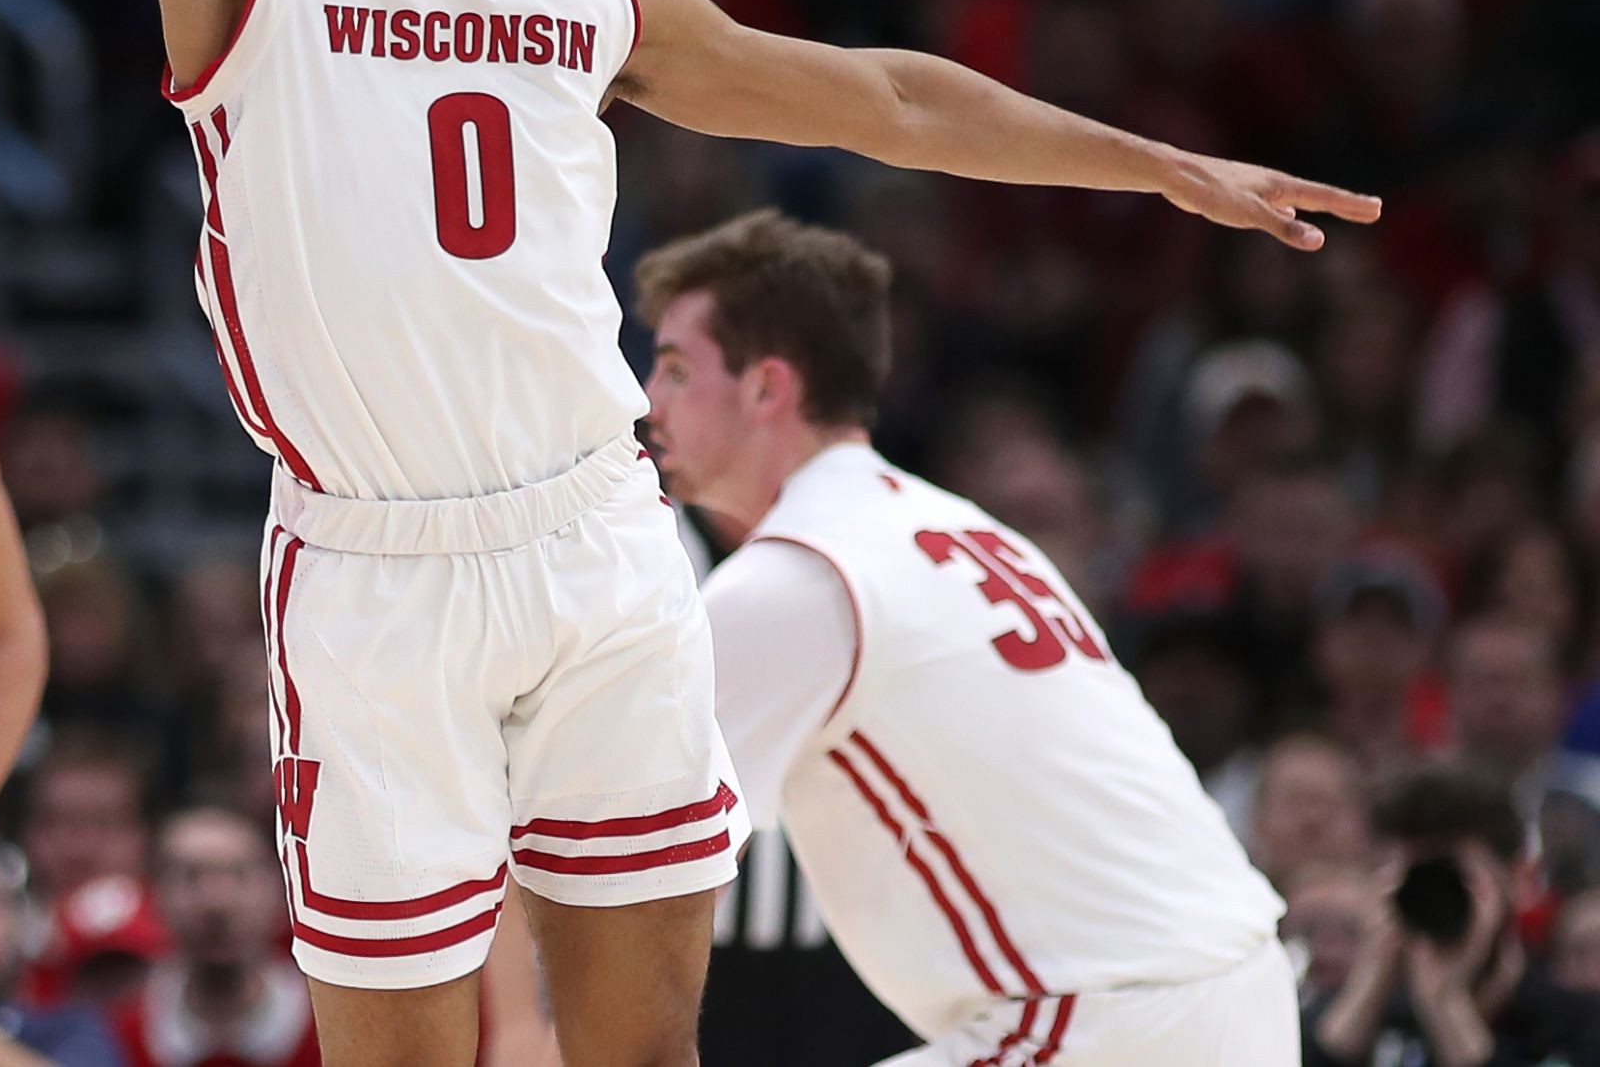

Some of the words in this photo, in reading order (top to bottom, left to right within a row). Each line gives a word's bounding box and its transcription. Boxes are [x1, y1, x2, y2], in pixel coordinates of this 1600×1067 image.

[323, 4, 597, 74] WISCONSIN
[427, 91, 517, 261] 0
[914, 529, 1108, 672] 35
